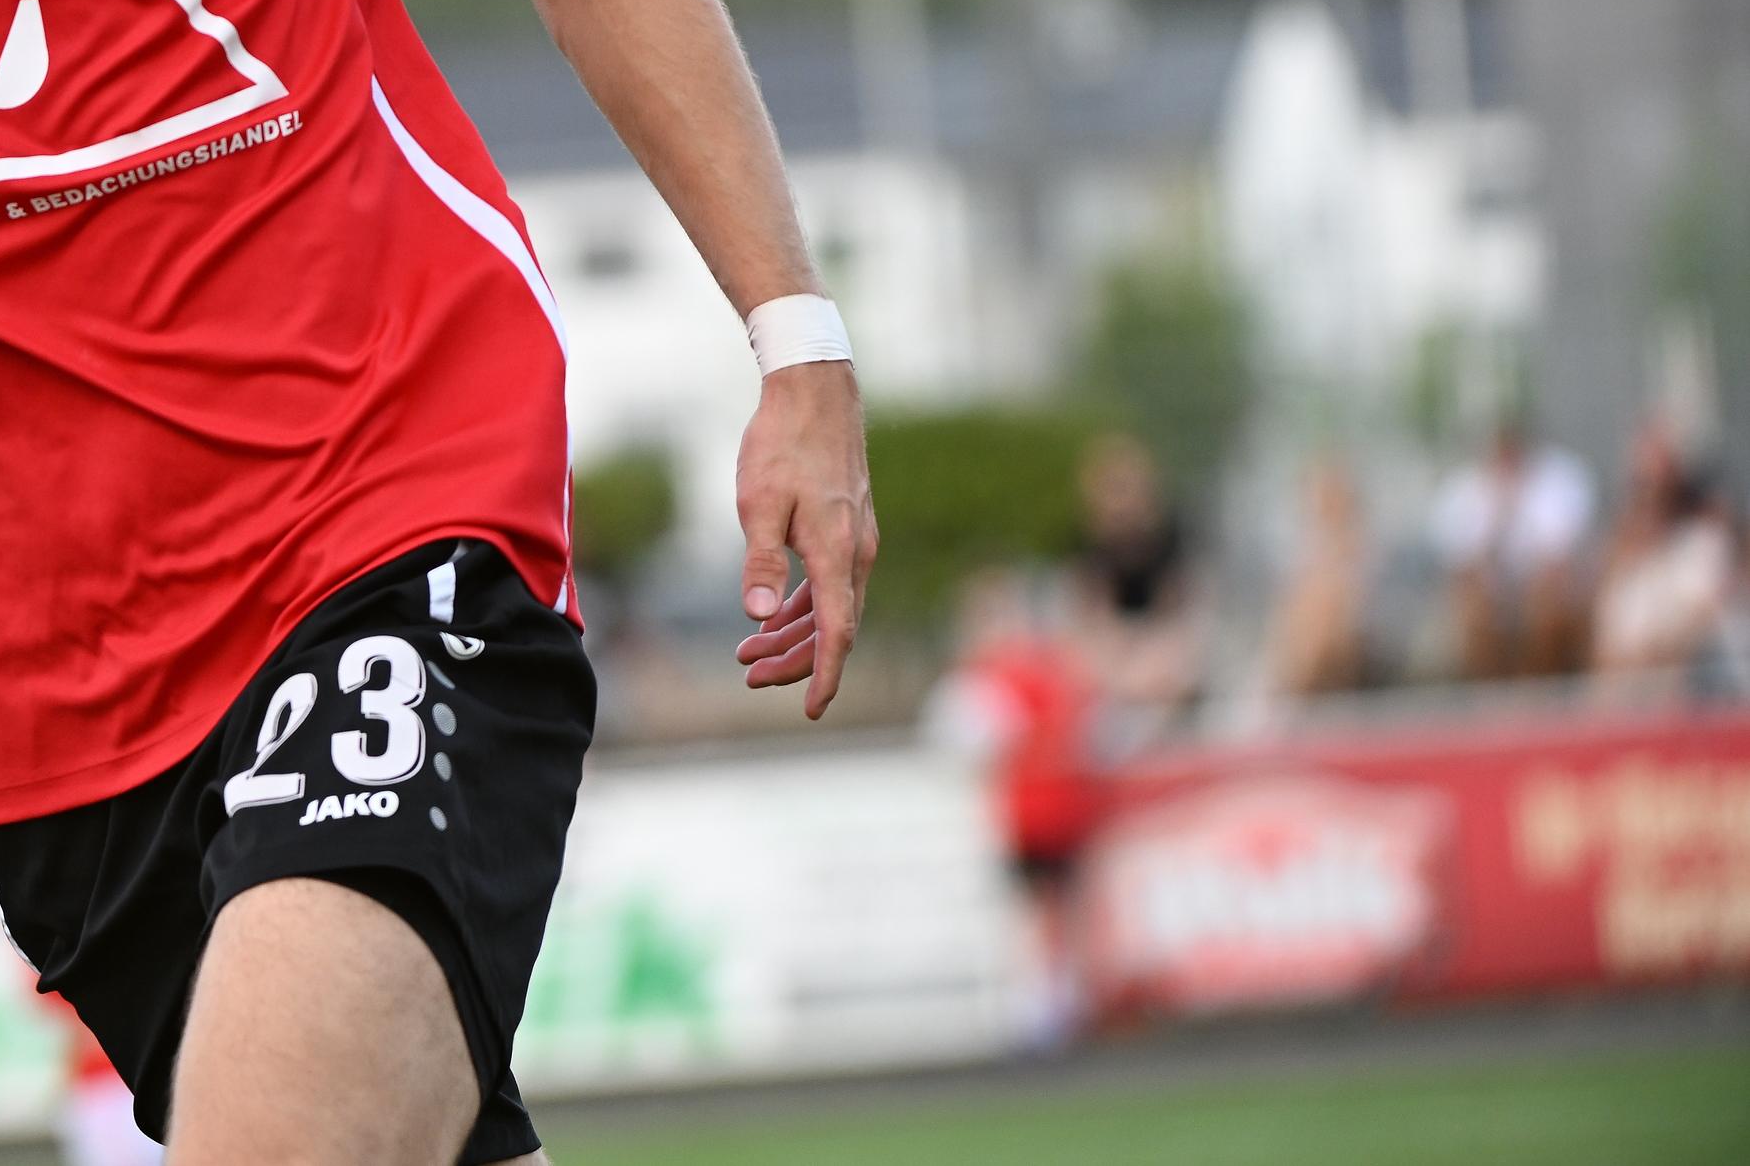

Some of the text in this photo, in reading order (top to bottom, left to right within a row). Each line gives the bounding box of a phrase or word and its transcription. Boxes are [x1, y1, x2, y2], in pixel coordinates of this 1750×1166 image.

[6, 202, 27, 219] &
[30, 110, 303, 213] BEDACHUNGSHANDEL
[224, 635, 427, 818] 23
[299, 790, 400, 827] JAKO
